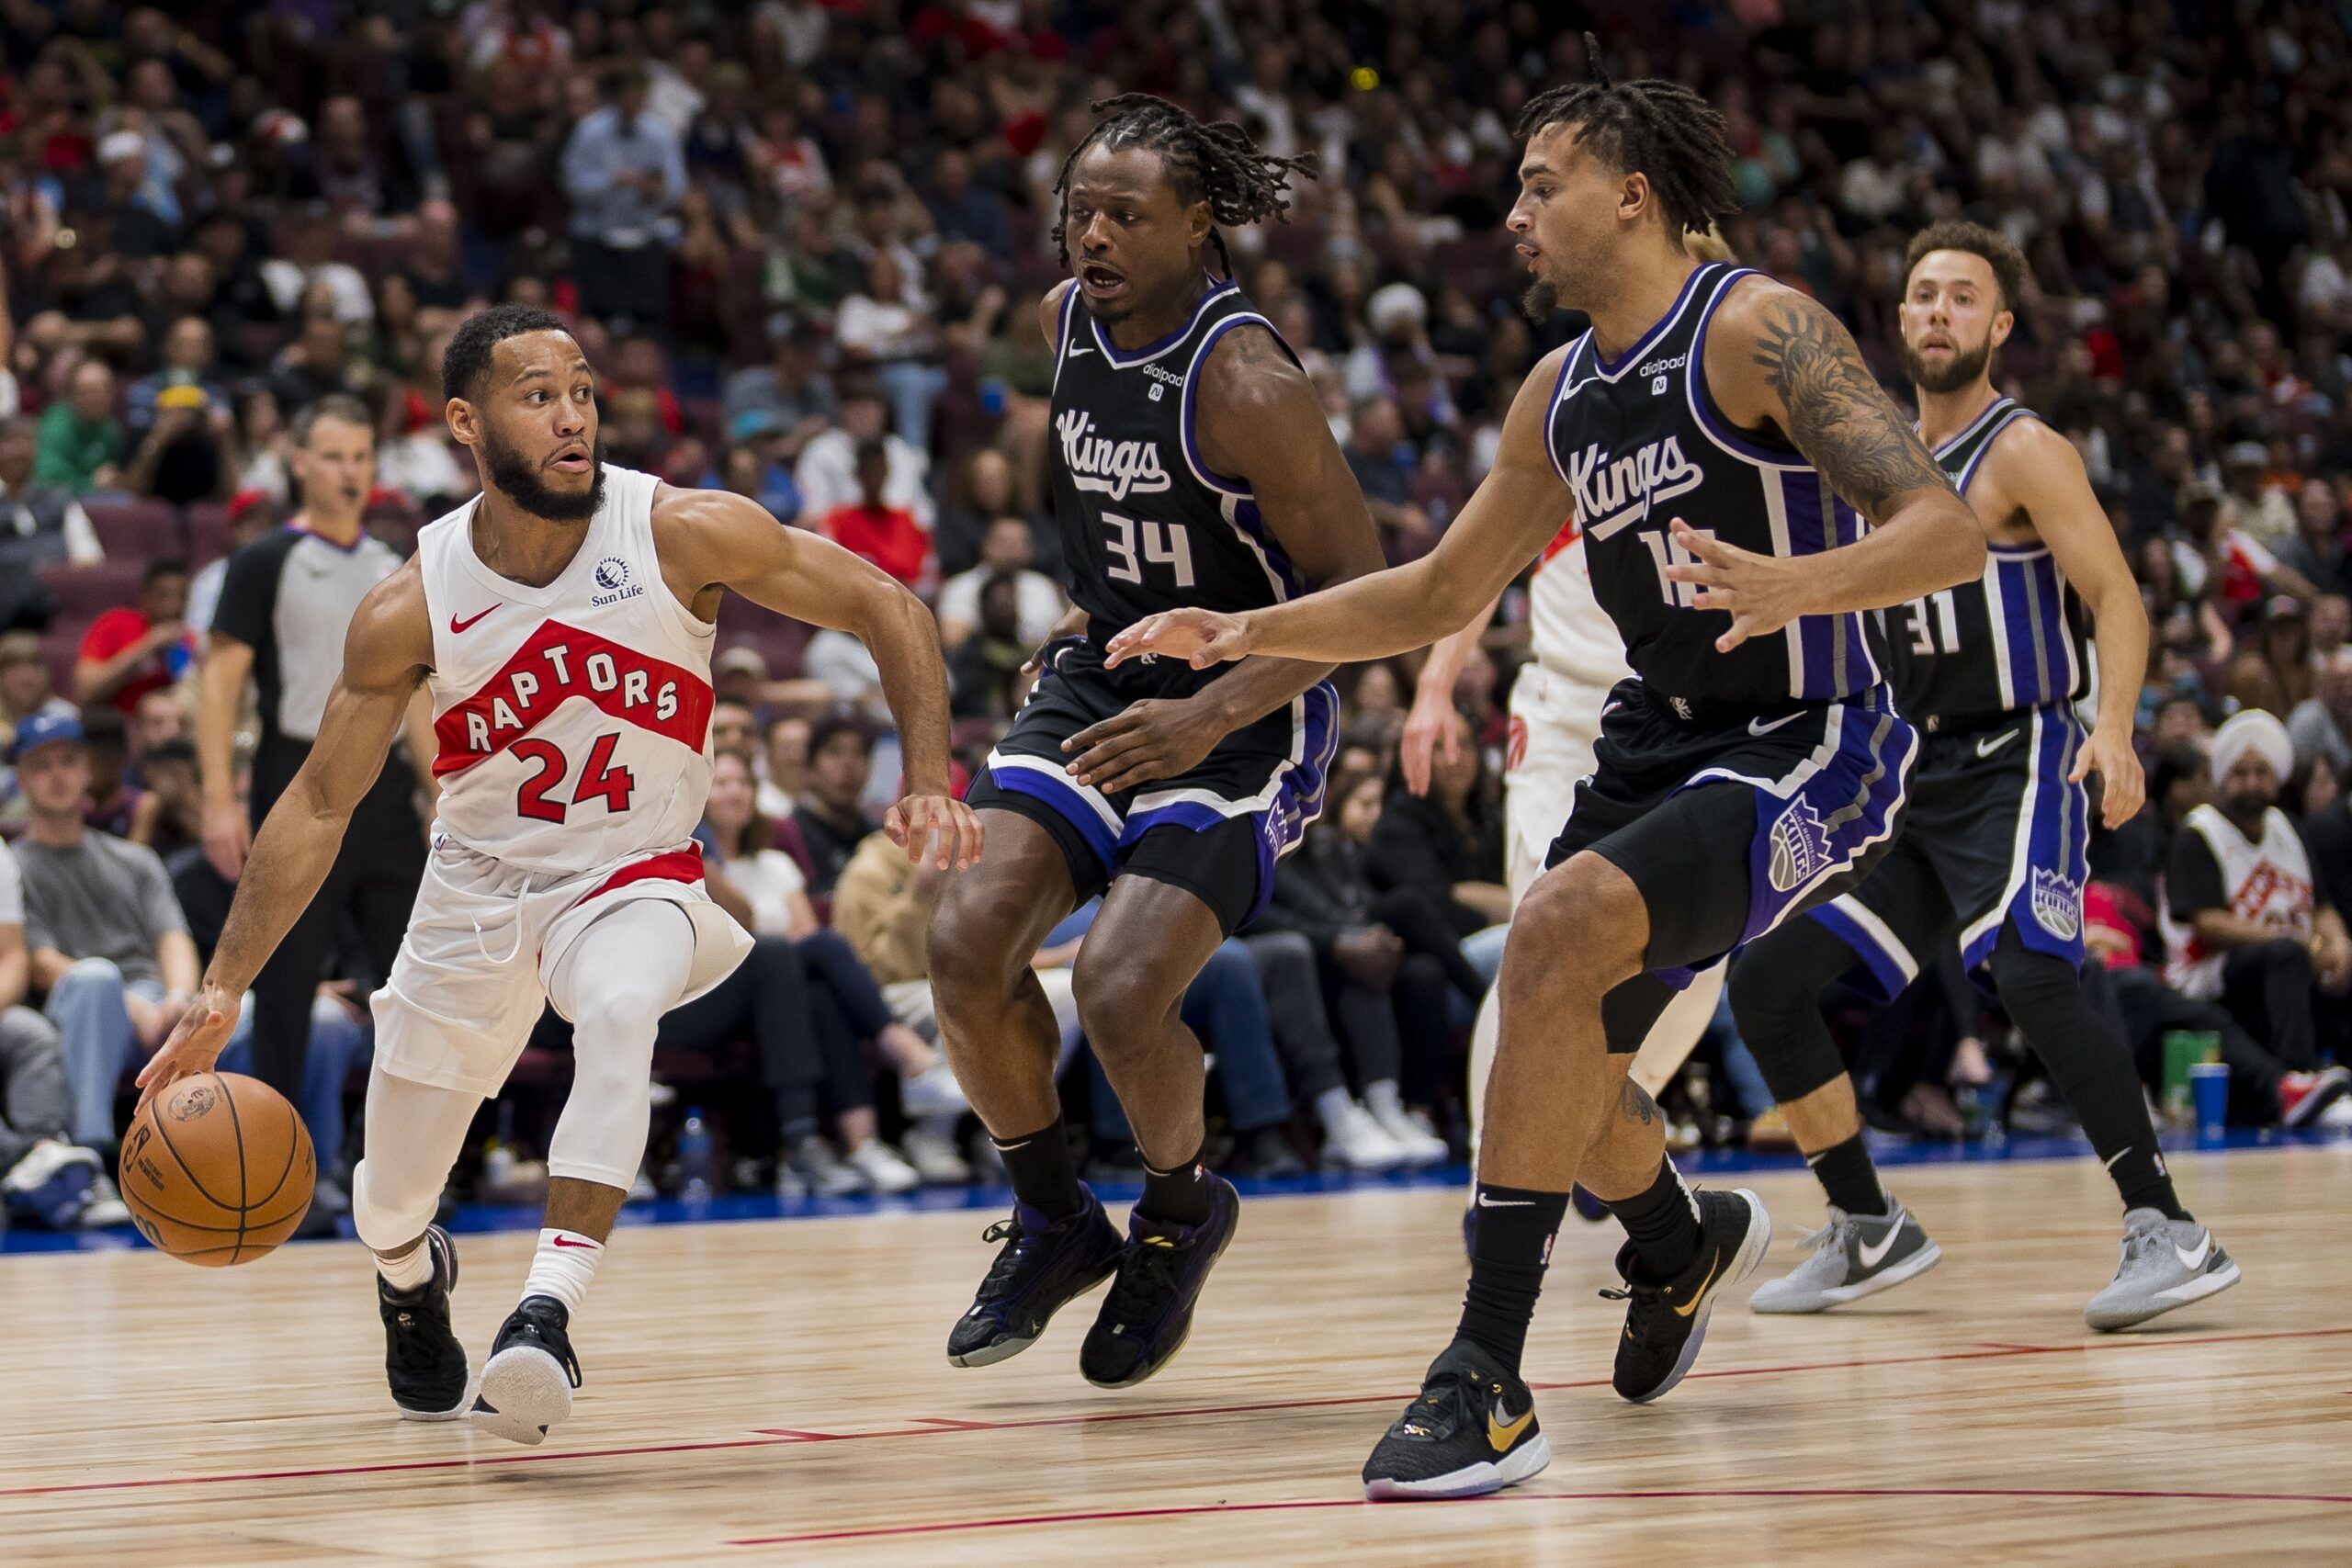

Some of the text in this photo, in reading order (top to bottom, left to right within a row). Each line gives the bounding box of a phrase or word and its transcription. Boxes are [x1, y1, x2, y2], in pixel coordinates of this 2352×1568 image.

[1143, 363, 1185, 387] dialpad
[1056, 409, 1171, 501] Kings
[1569, 436, 1703, 541] Kings
[1102, 512, 1194, 587] 34
[592, 584, 644, 607] Sun Life
[1903, 589, 1960, 655] 31
[466, 643, 679, 752] RAPTORS
[508, 731, 635, 825] 24
